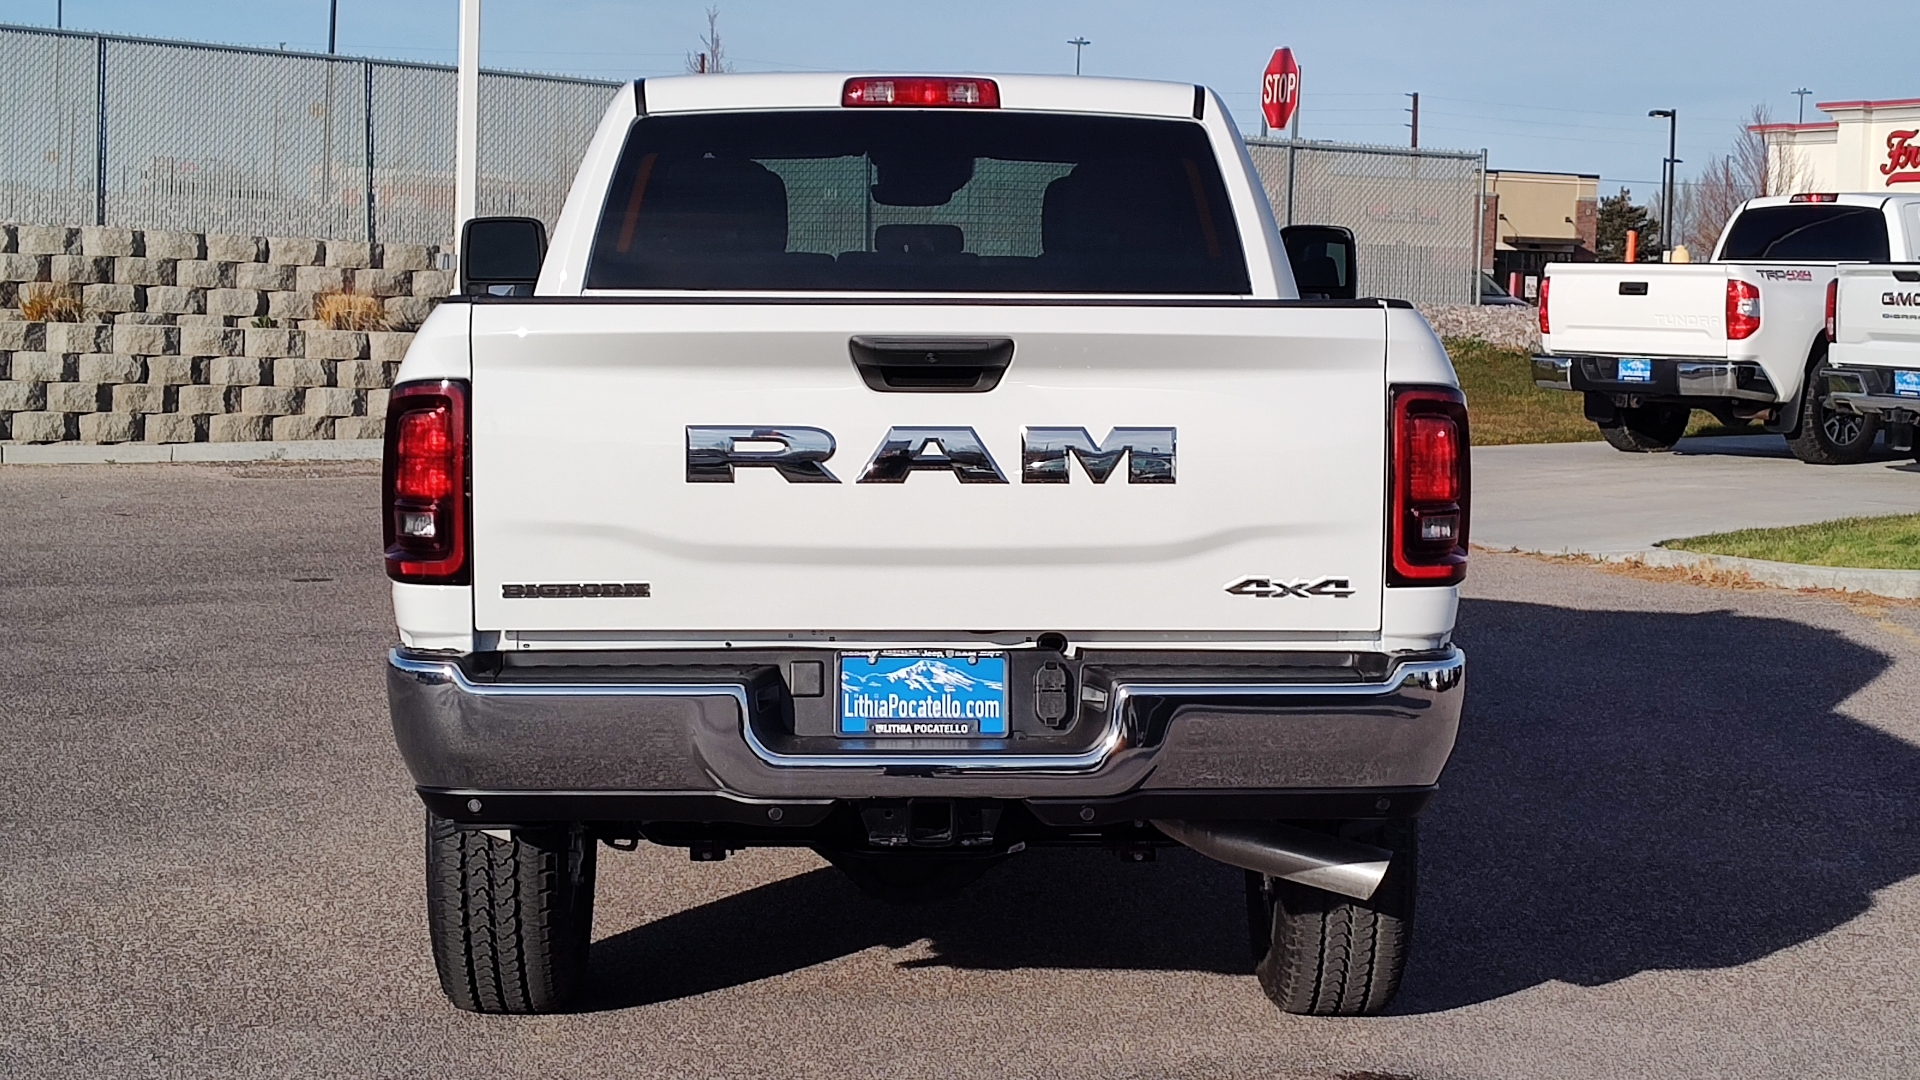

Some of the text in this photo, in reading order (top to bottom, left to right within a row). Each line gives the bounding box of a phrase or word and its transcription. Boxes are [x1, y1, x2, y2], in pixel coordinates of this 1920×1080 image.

[1264, 73, 1297, 105] STOP
[1881, 292, 1920, 306] GMC
[1654, 314, 1721, 328] TUNDRA
[685, 425, 1178, 485] RAM
[844, 693, 1000, 718] LithiaPocatello.com
[884, 723, 968, 734] LITHIA POCATELLO
